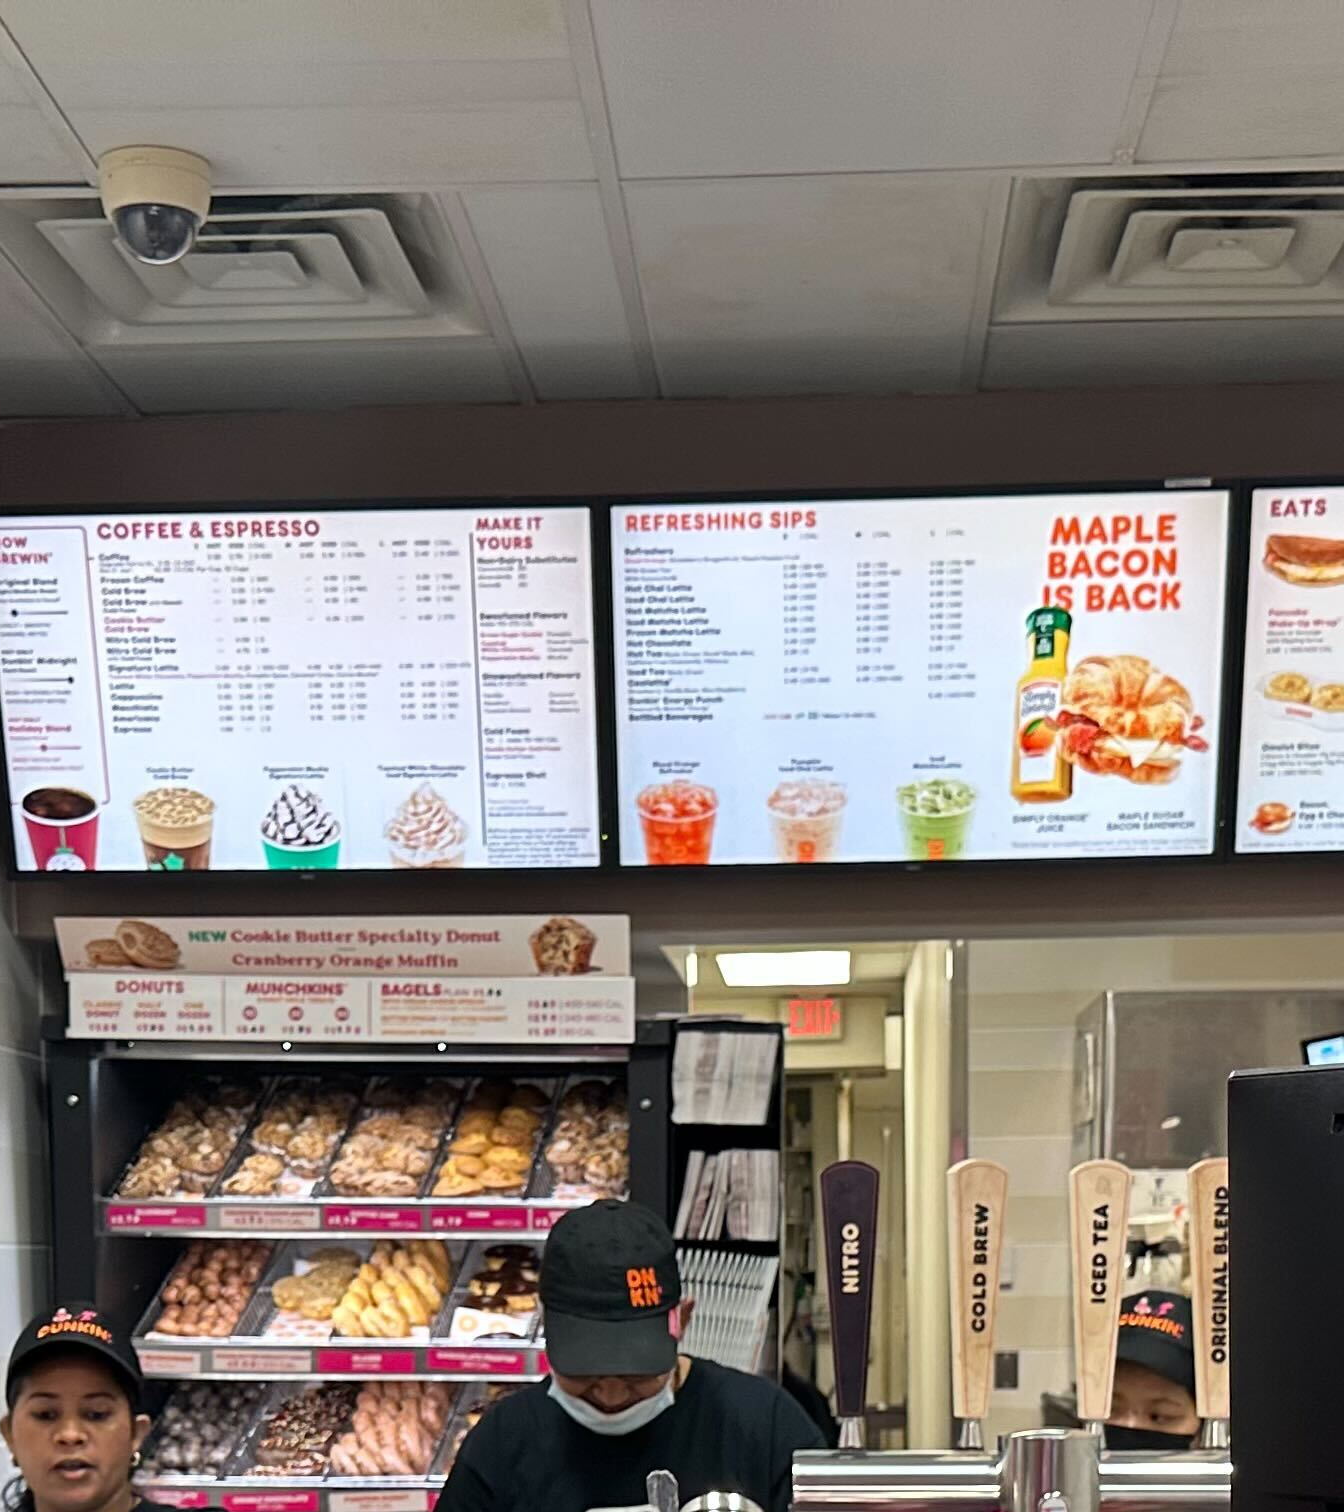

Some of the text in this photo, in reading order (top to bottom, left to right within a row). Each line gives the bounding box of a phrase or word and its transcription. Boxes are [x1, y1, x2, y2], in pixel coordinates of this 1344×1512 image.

[1270, 499, 1327, 518] EATS
[97, 519, 320, 539] COFFEE & ESPRESSO
[476, 517, 544, 530] MAKE IT
[625, 510, 817, 533] REFRESHING SIPS
[1051, 514, 1177, 546] MAPLE
[476, 536, 533, 550] YOURS
[1048, 548, 1178, 579] BACON
[1043, 582, 1181, 614] IS BACK
[188, 930, 500, 946] NEW Cookie Butter Specialty Donut
[232, 954, 458, 970] Cranberry Orange Muffin
[116, 980, 184, 994] DONUTS
[381, 984, 442, 996] BAGELS
[789, 998, 834, 1034] EXIT
[842, 1223, 860, 1294] NITRO
[1091, 1204, 1110, 1304] ICED TEA
[626, 1266, 656, 1288] DN
[972, 1203, 990, 1333] COLD BREW
[1211, 1186, 1230, 1364] ORIGINAL BLEND
